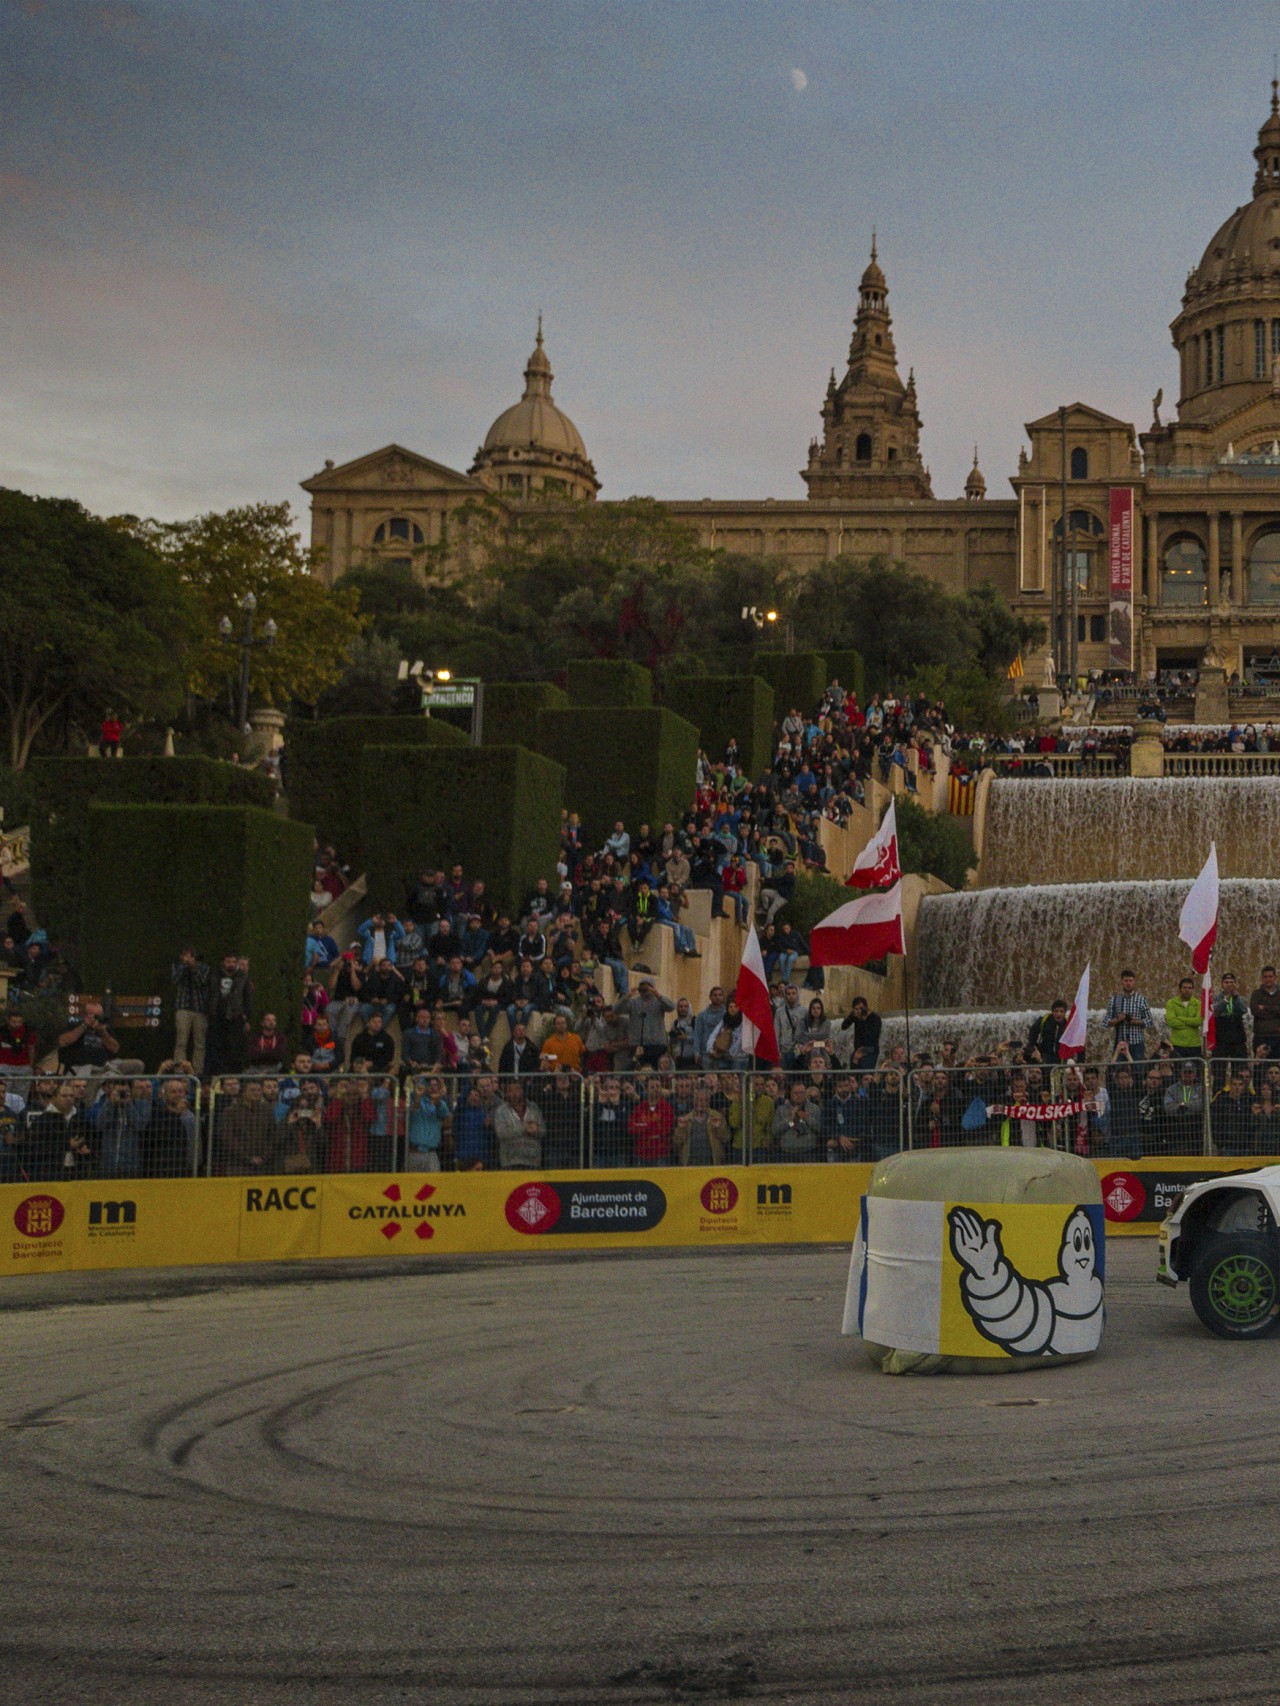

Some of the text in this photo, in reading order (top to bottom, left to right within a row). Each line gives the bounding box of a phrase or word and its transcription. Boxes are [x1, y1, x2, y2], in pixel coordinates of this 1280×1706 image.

[1111, 523, 1121, 584] MUSEU NACIONAL
[1121, 510, 1131, 584] D'ART DE CATALUNYA
[1017, 1103, 1074, 1119] POLSKA
[1154, 1183, 1188, 1194] Ajunta
[246, 1186, 317, 1212] RACC
[571, 1191, 648, 1205] Ajuntament de
[348, 1204, 467, 1220] CATALUNYA
[570, 1204, 648, 1219] Barcelona
